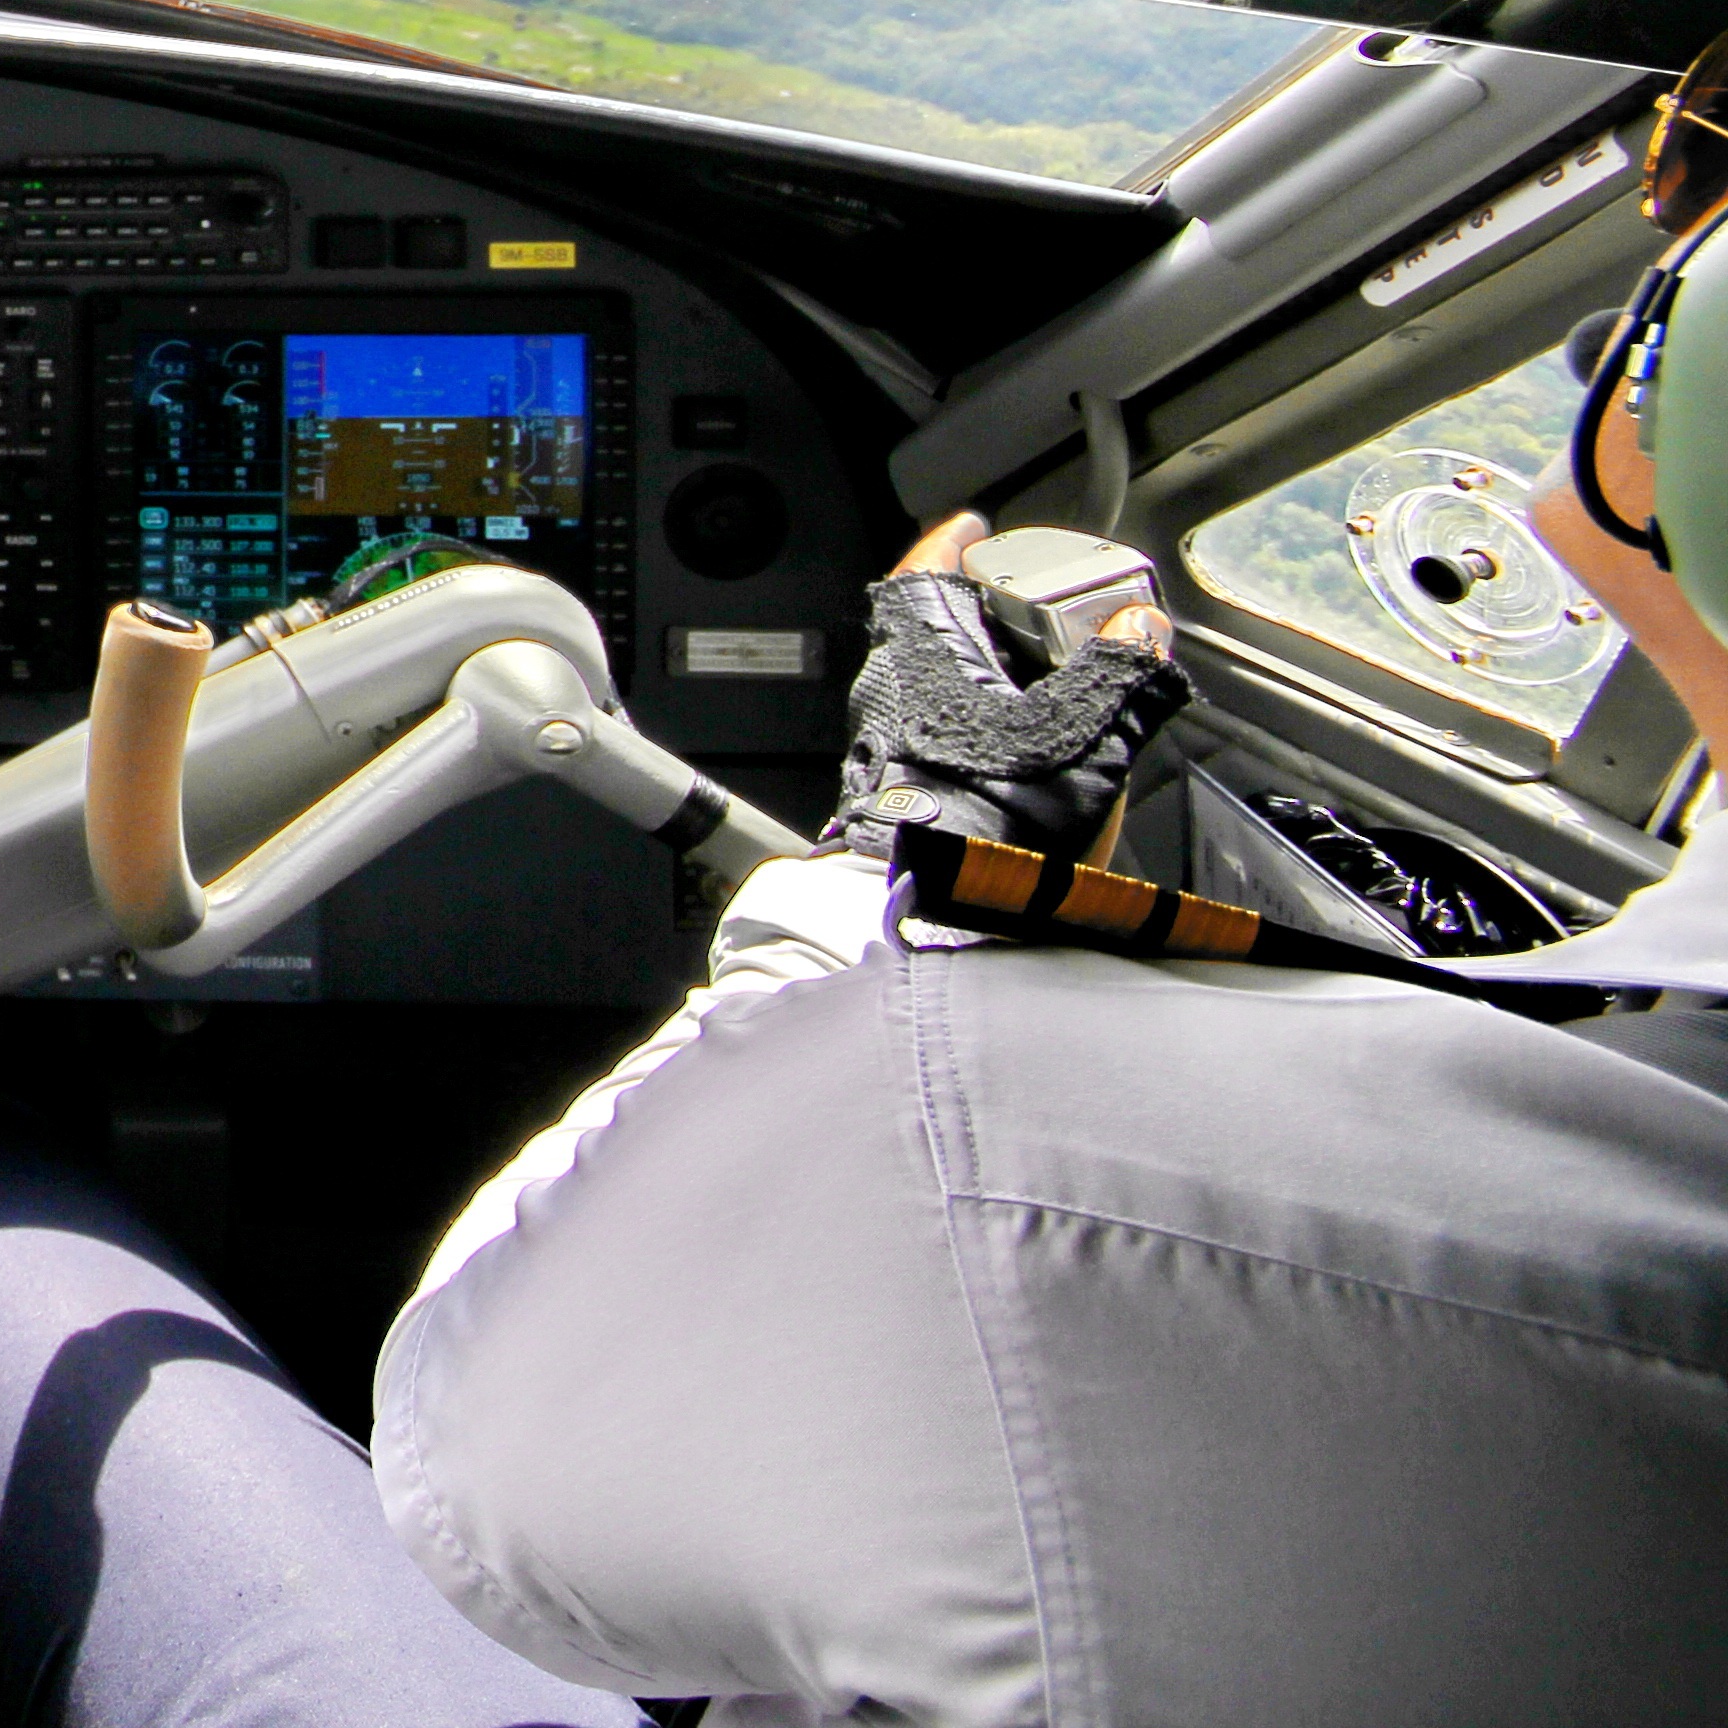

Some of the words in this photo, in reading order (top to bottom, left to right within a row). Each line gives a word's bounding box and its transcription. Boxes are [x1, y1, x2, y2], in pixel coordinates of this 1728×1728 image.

[1539, 141, 1602, 188] NO
[1372, 207, 1494, 283] STEP
[5, 306, 36, 316] BARO
[5, 535, 37, 545] RADIO
